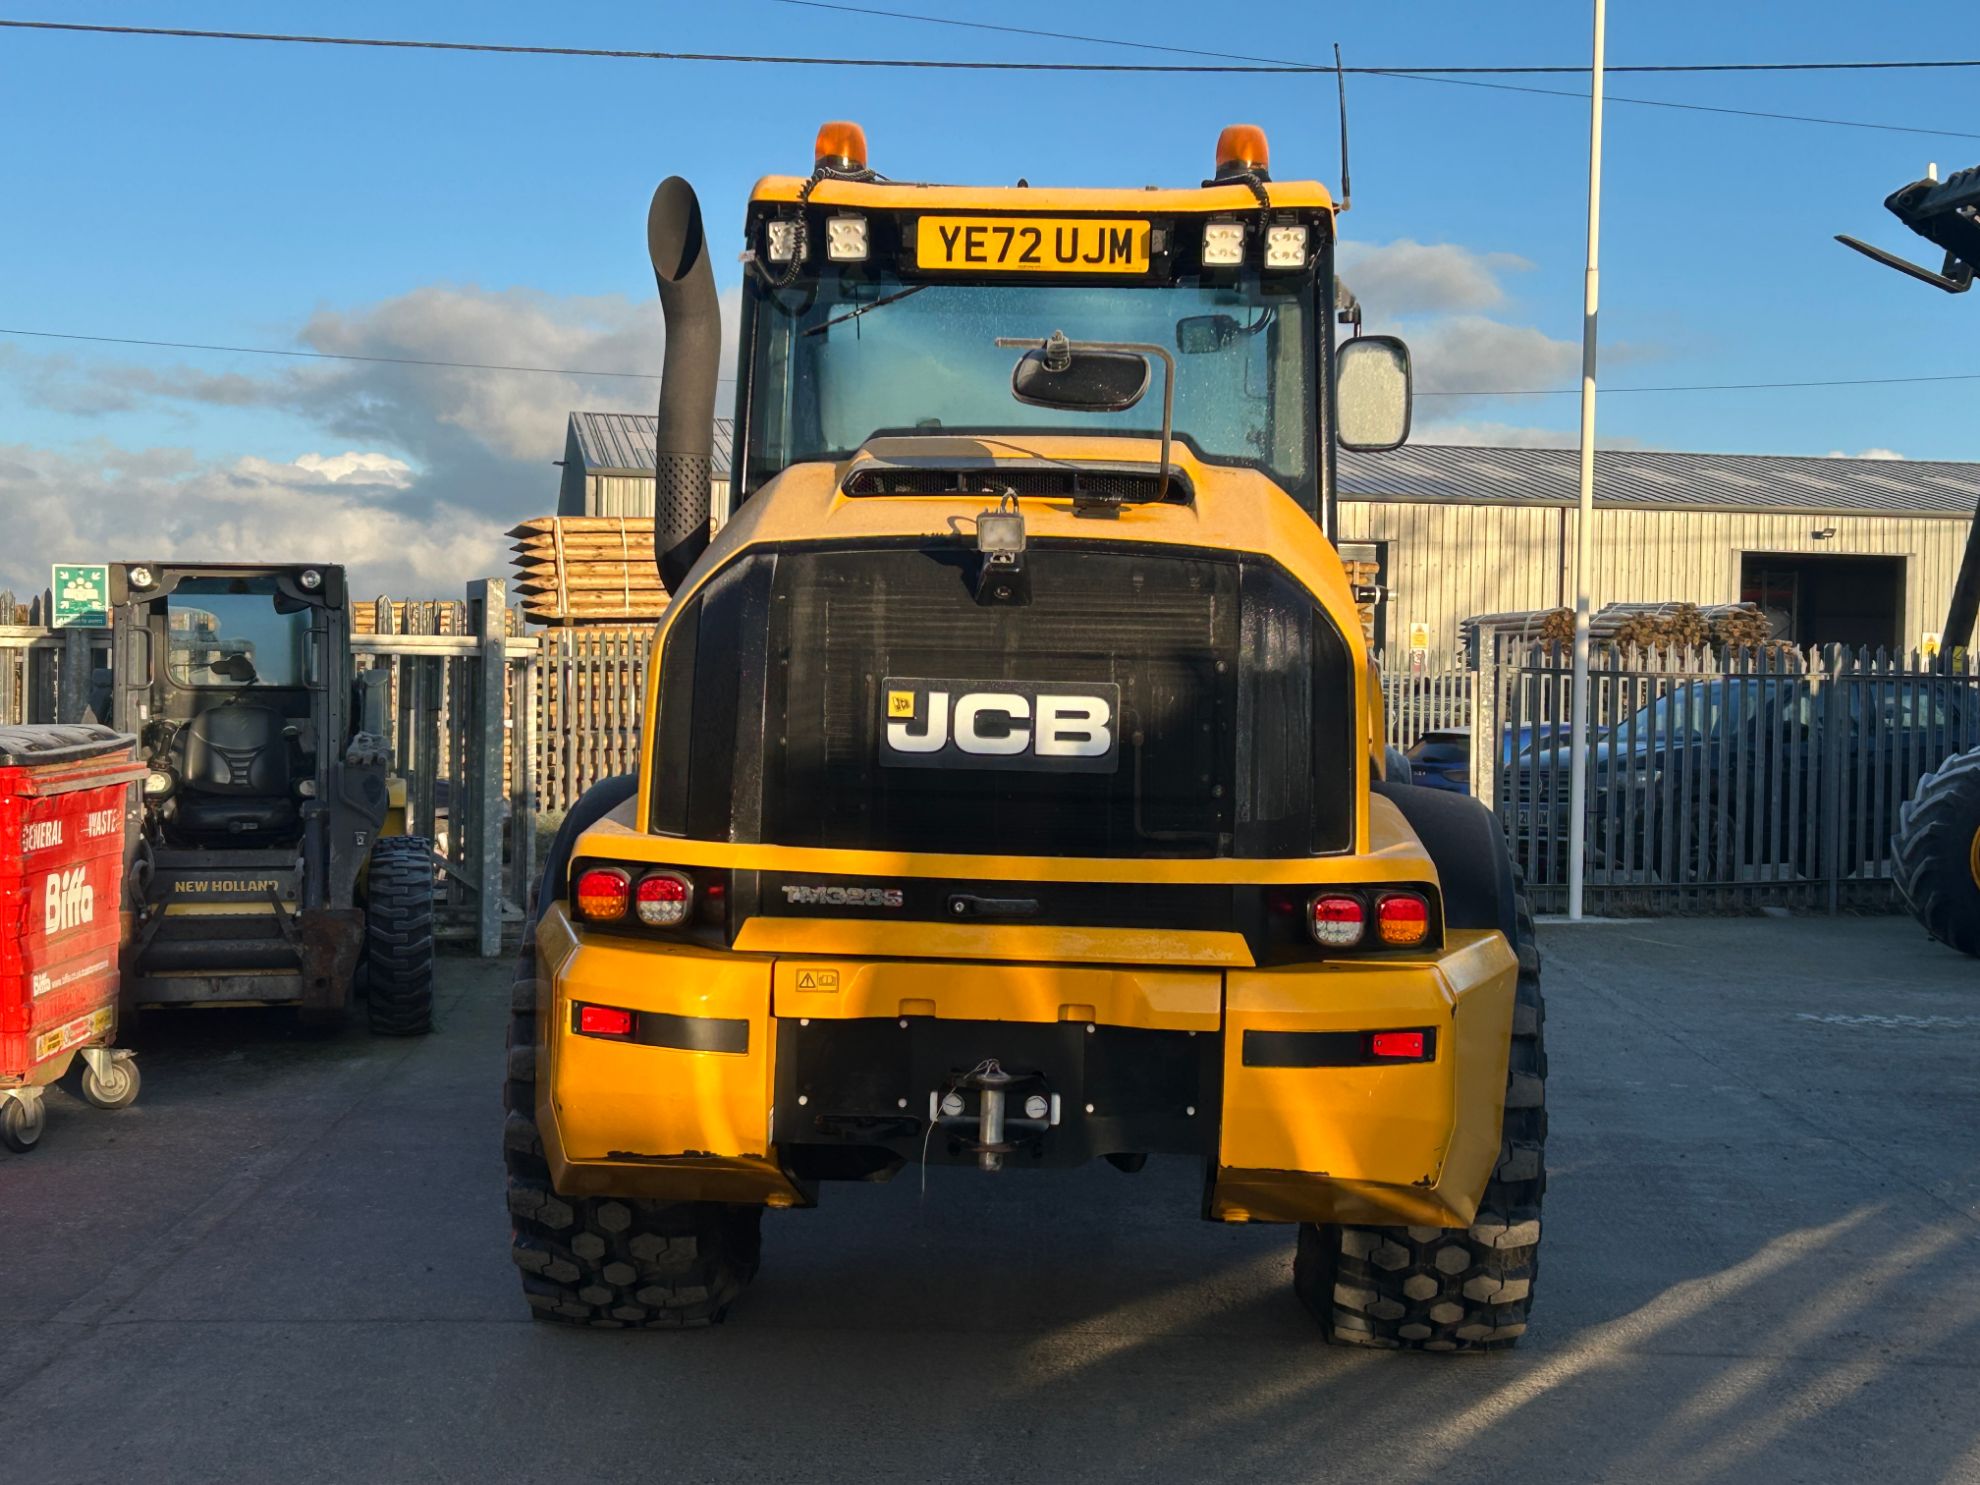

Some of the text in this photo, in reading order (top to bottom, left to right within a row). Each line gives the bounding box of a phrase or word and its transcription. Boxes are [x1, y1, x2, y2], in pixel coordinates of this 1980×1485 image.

[939, 226, 1133, 264] YE72 UJM
[887, 690, 1111, 756] JCB
[22, 819, 63, 852] GENERAL
[45, 865, 94, 936] Biffa
[175, 881, 208, 893] NEW
